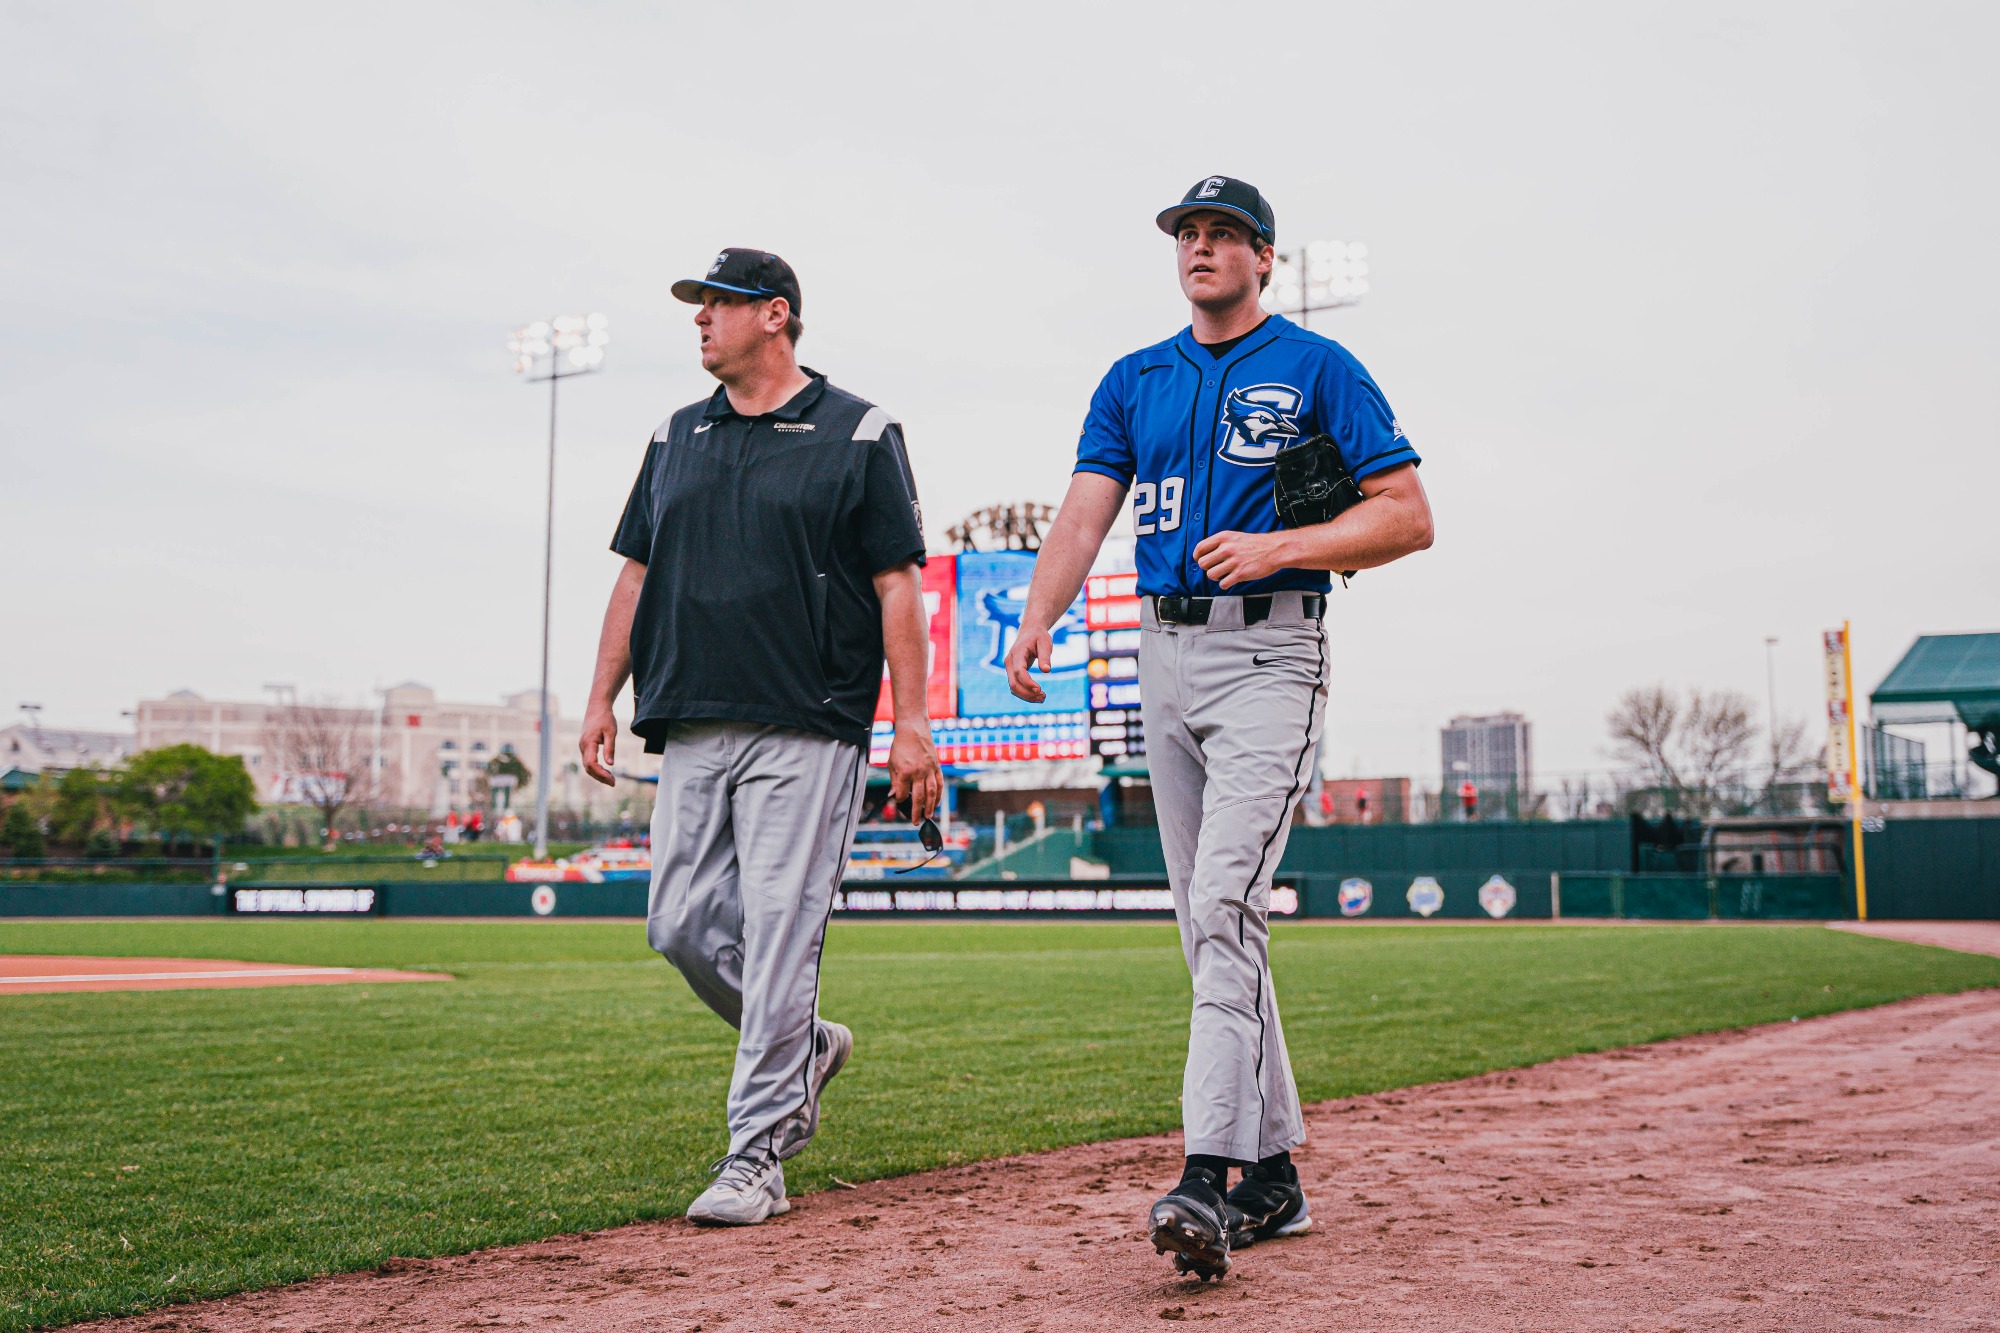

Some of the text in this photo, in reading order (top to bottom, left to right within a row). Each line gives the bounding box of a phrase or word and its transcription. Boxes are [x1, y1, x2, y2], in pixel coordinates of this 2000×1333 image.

[1196, 177, 1226, 198] C
[708, 253, 729, 275] C
[1133, 476, 1186, 536] 29
